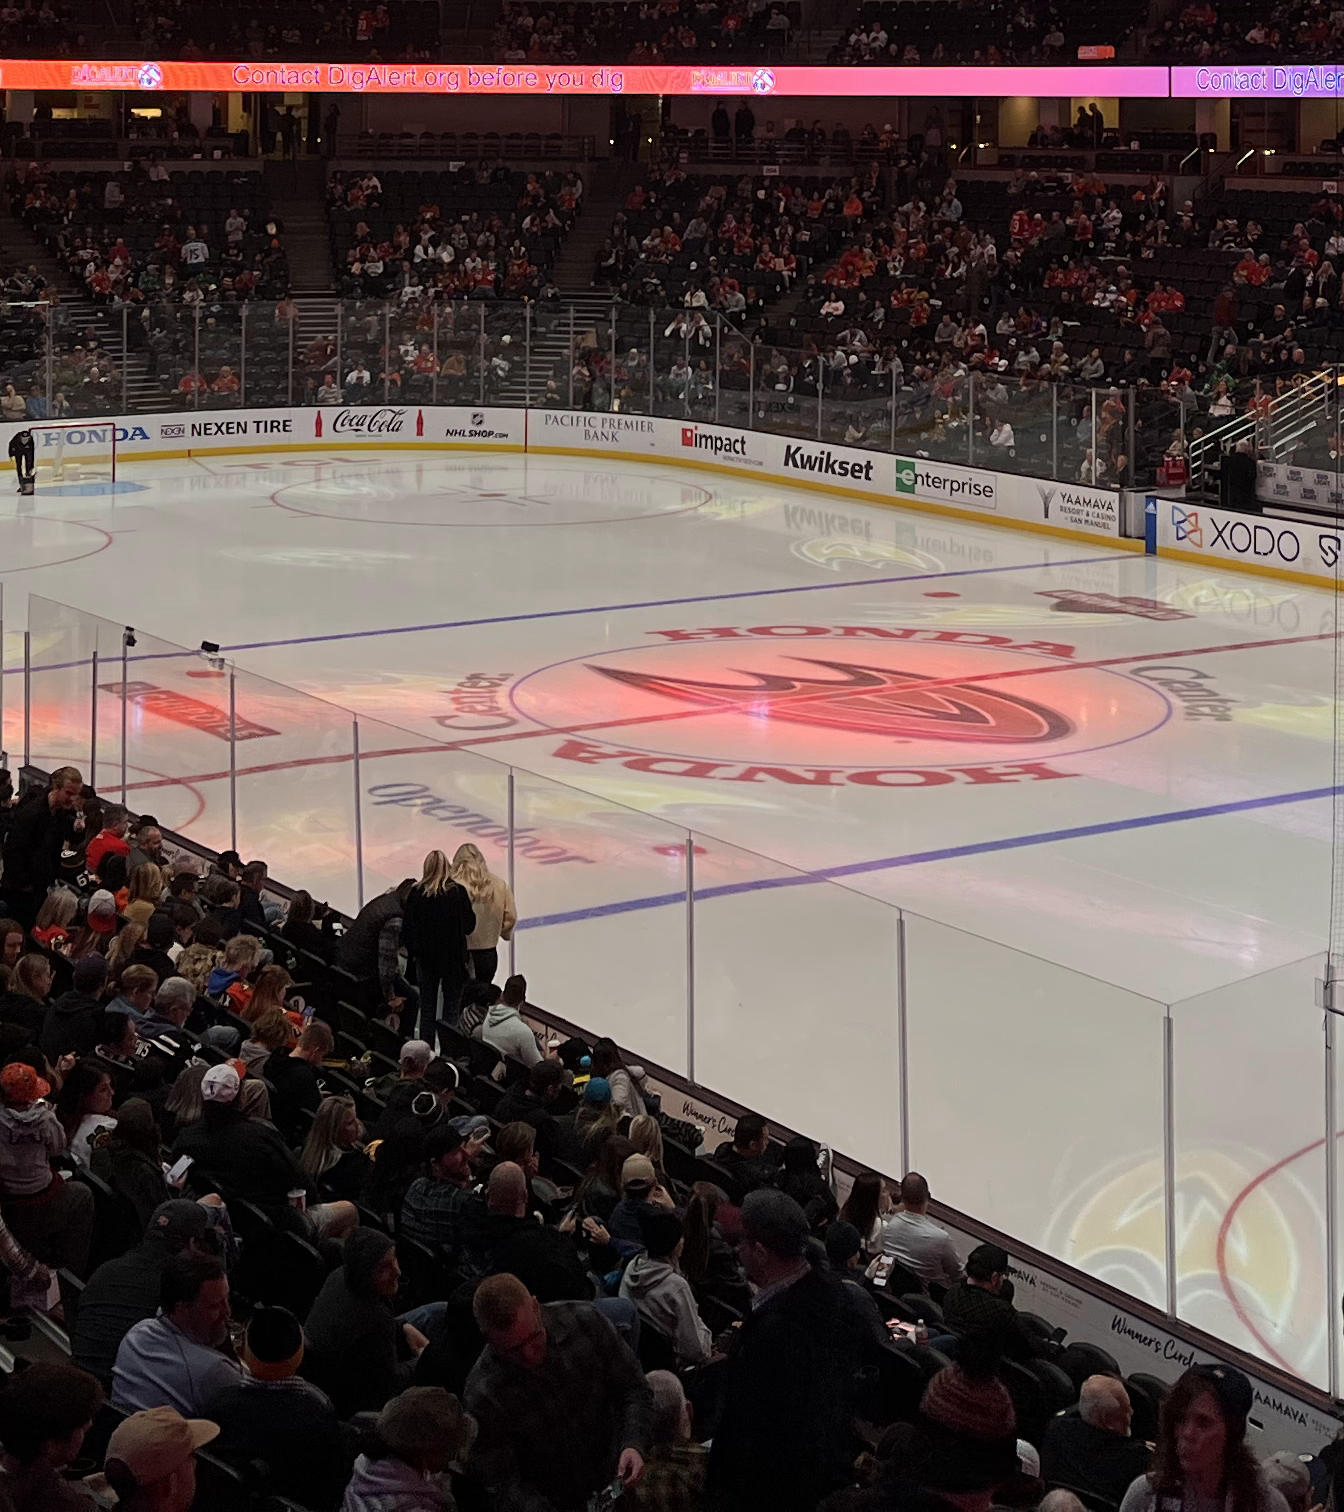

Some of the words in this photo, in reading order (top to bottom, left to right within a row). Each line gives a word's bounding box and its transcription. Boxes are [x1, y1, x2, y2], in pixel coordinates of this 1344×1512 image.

[1195, 66, 1267, 92] Contact
[42, 425, 151, 448] HONDA
[191, 420, 248, 438] NEXEN
[252, 418, 293, 435] TIRE
[332, 407, 408, 434] Coca-Cola
[544, 413, 596, 429] PACIFIC
[601, 417, 655, 435] PREMIER
[583, 429, 620, 444] BANK
[693, 424, 747, 456] impact
[783, 444, 873, 482] Kwikset
[897, 459, 995, 500] enterprise
[1210, 518, 1301, 563] XODO
[646, 624, 1078, 660] HONDA
[1130, 665, 1236, 723] Center
[552, 738, 1080, 788] HONDA
[1111, 1314, 1162, 1353] Winner's
